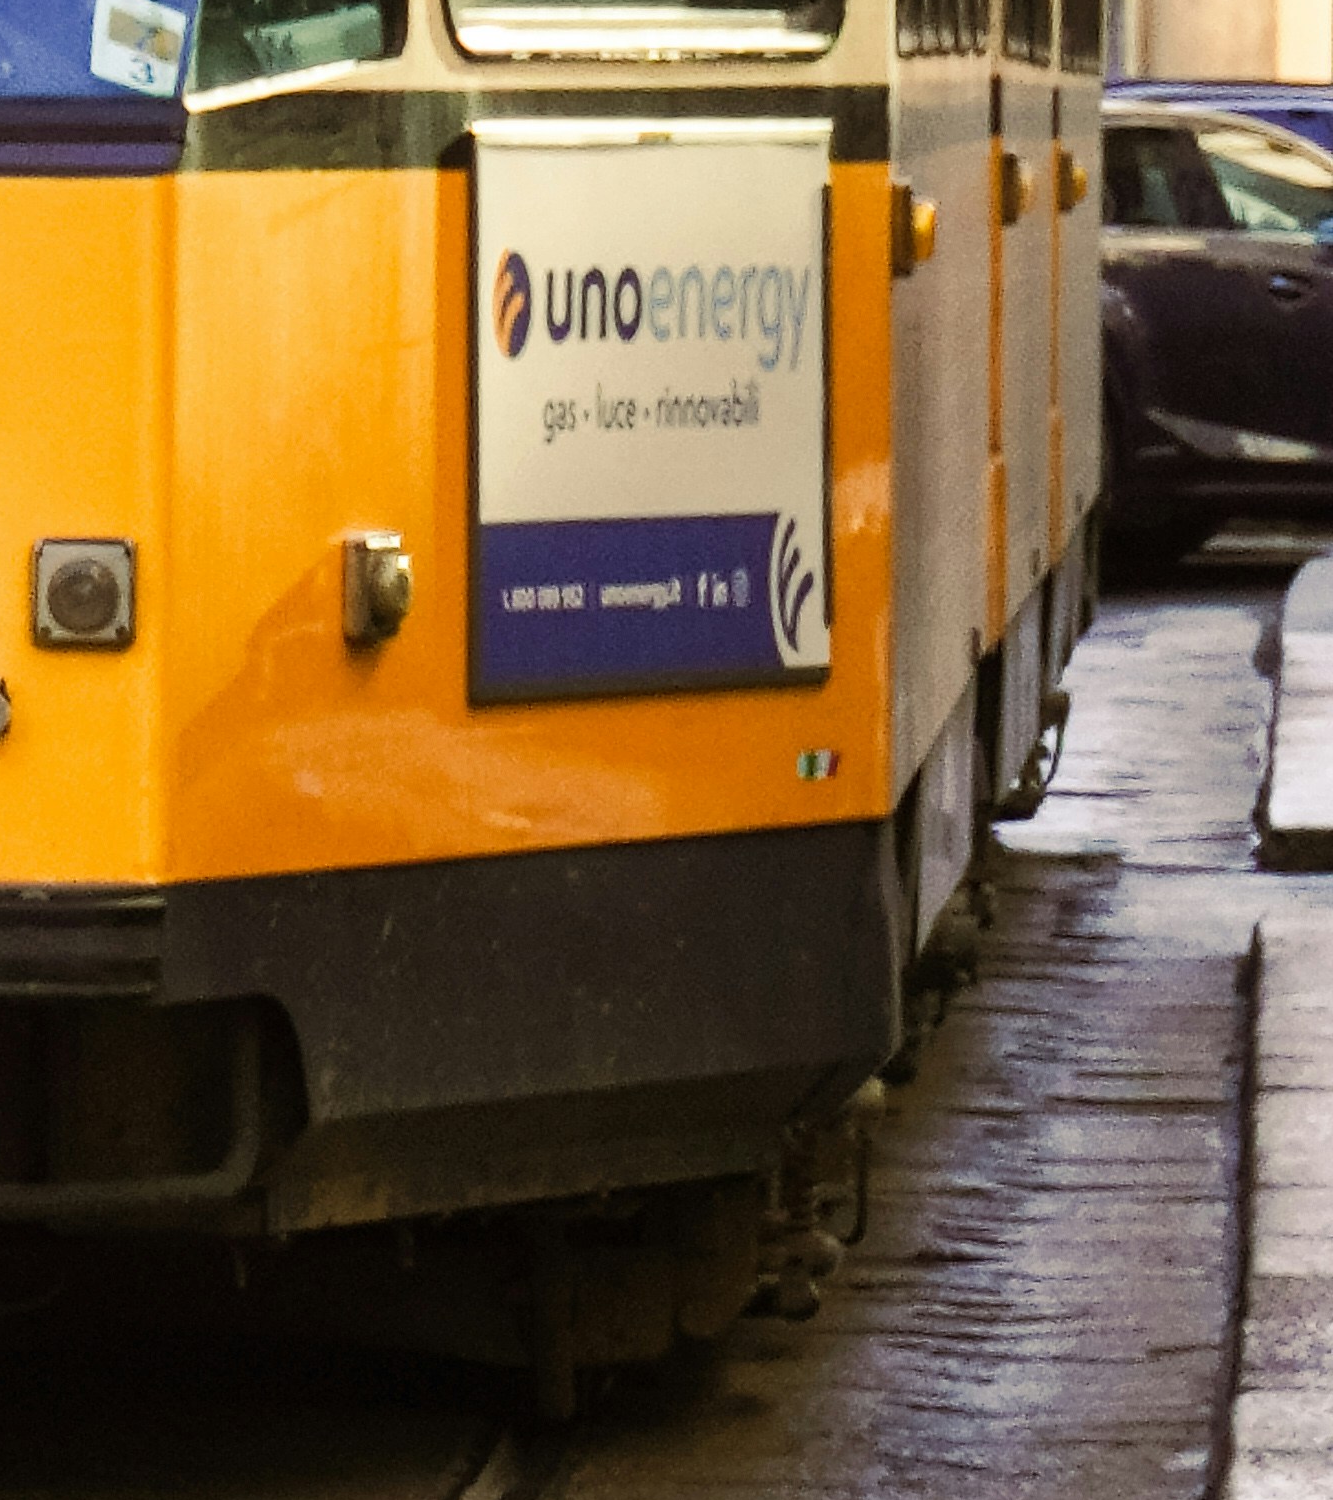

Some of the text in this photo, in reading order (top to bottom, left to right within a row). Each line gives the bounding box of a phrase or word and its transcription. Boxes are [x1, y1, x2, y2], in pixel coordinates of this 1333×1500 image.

[544, 262, 812, 371] unoenergy
[543, 398, 577, 444] gas
[597, 381, 637, 430] luce
